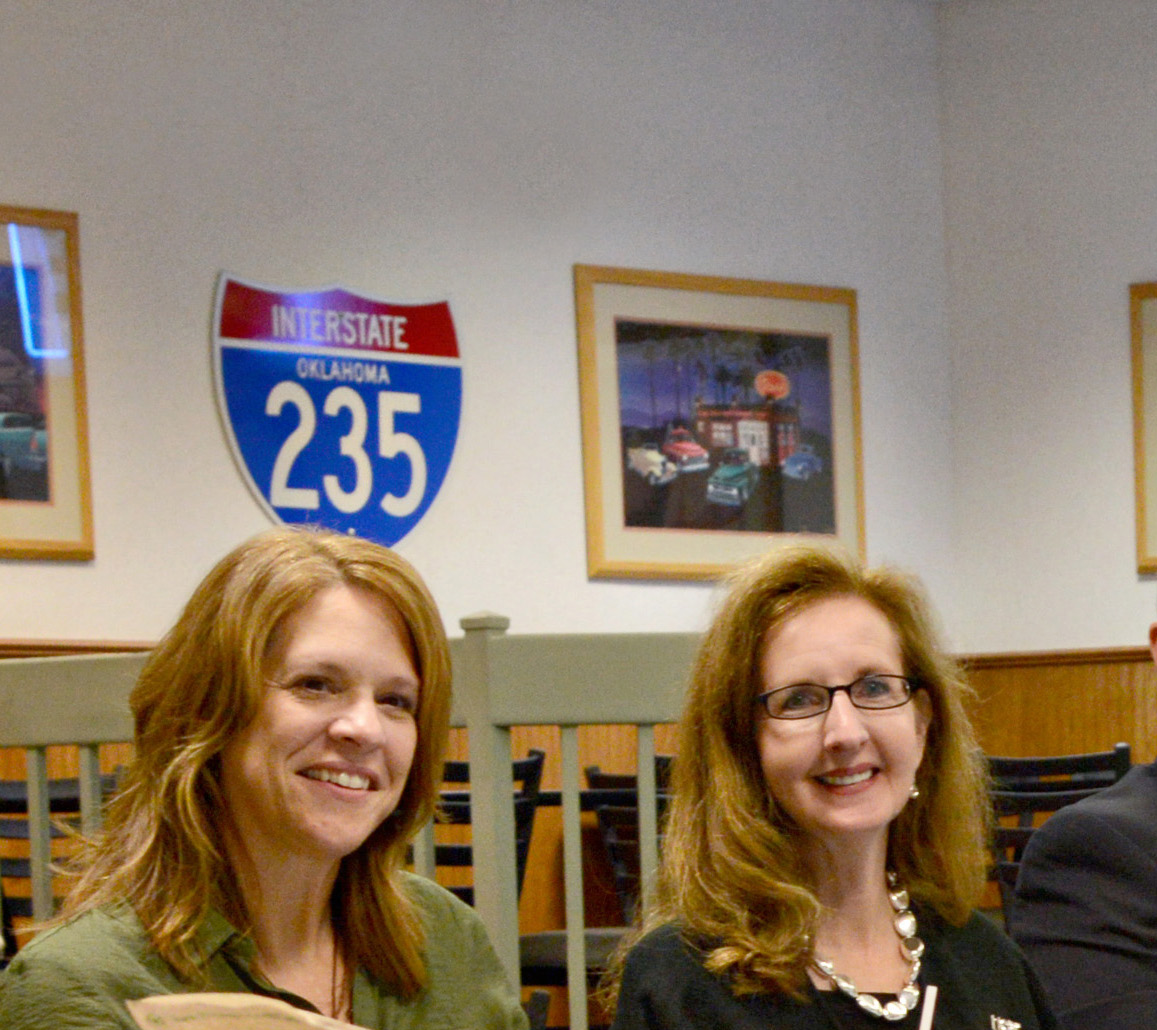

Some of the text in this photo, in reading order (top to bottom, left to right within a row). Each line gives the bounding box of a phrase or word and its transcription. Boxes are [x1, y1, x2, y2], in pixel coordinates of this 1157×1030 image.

[270, 303, 409, 350] INTERSTATE
[296, 357, 391, 385] OKLAHOMA
[264, 380, 428, 518] 235
